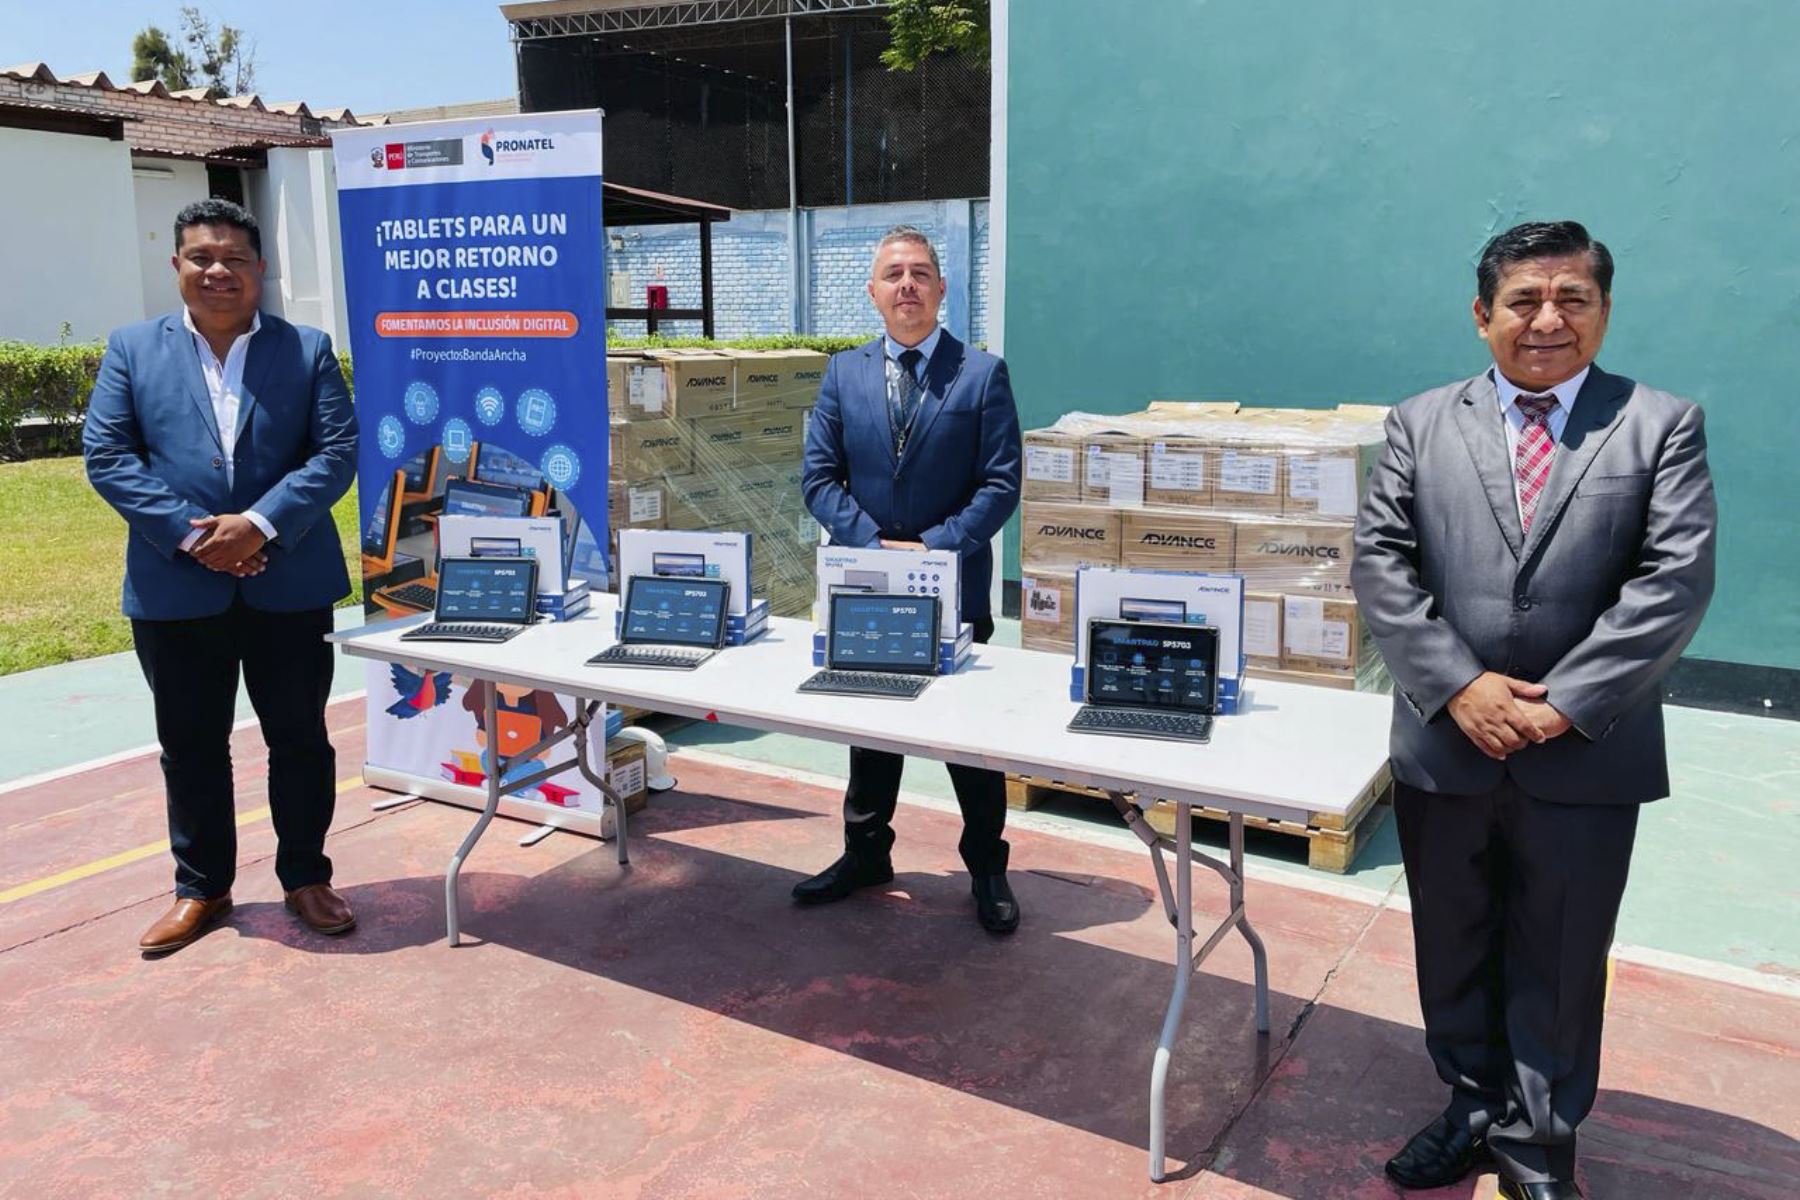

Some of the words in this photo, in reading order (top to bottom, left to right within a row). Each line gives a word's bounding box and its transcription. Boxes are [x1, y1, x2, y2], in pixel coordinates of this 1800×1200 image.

[496, 138, 555, 152] PRONATEL
[376, 217, 466, 247] ¡TABLETS
[470, 214, 527, 237] PARA
[532, 213, 567, 235] UN
[385, 248, 450, 271] MEJOR
[455, 245, 558, 268] RETORNO
[417, 279, 431, 299] A
[436, 276, 517, 300] CLASES!
[381, 318, 451, 331] FOMENTAMOS
[452, 318, 464, 330] LA
[465, 315, 519, 331] INCLUSIÓN
[523, 318, 568, 331] DIGITAL
[410, 348, 527, 363] #ProyectosBandaAncha
[686, 376, 726, 389] ADVANCE
[746, 374, 779, 384] ADVANCE
[763, 425, 794, 436] ADVANCE
[640, 437, 681, 450] ADVANCE
[1037, 524, 1106, 542] ADVANCE
[1139, 532, 1217, 551] ADVANCE
[1255, 541, 1341, 560] ADVANCE
[892, 606, 918, 615] SP5703
[1113, 635, 1160, 648] SMARTPAD
[1162, 640, 1192, 650] SP5703
